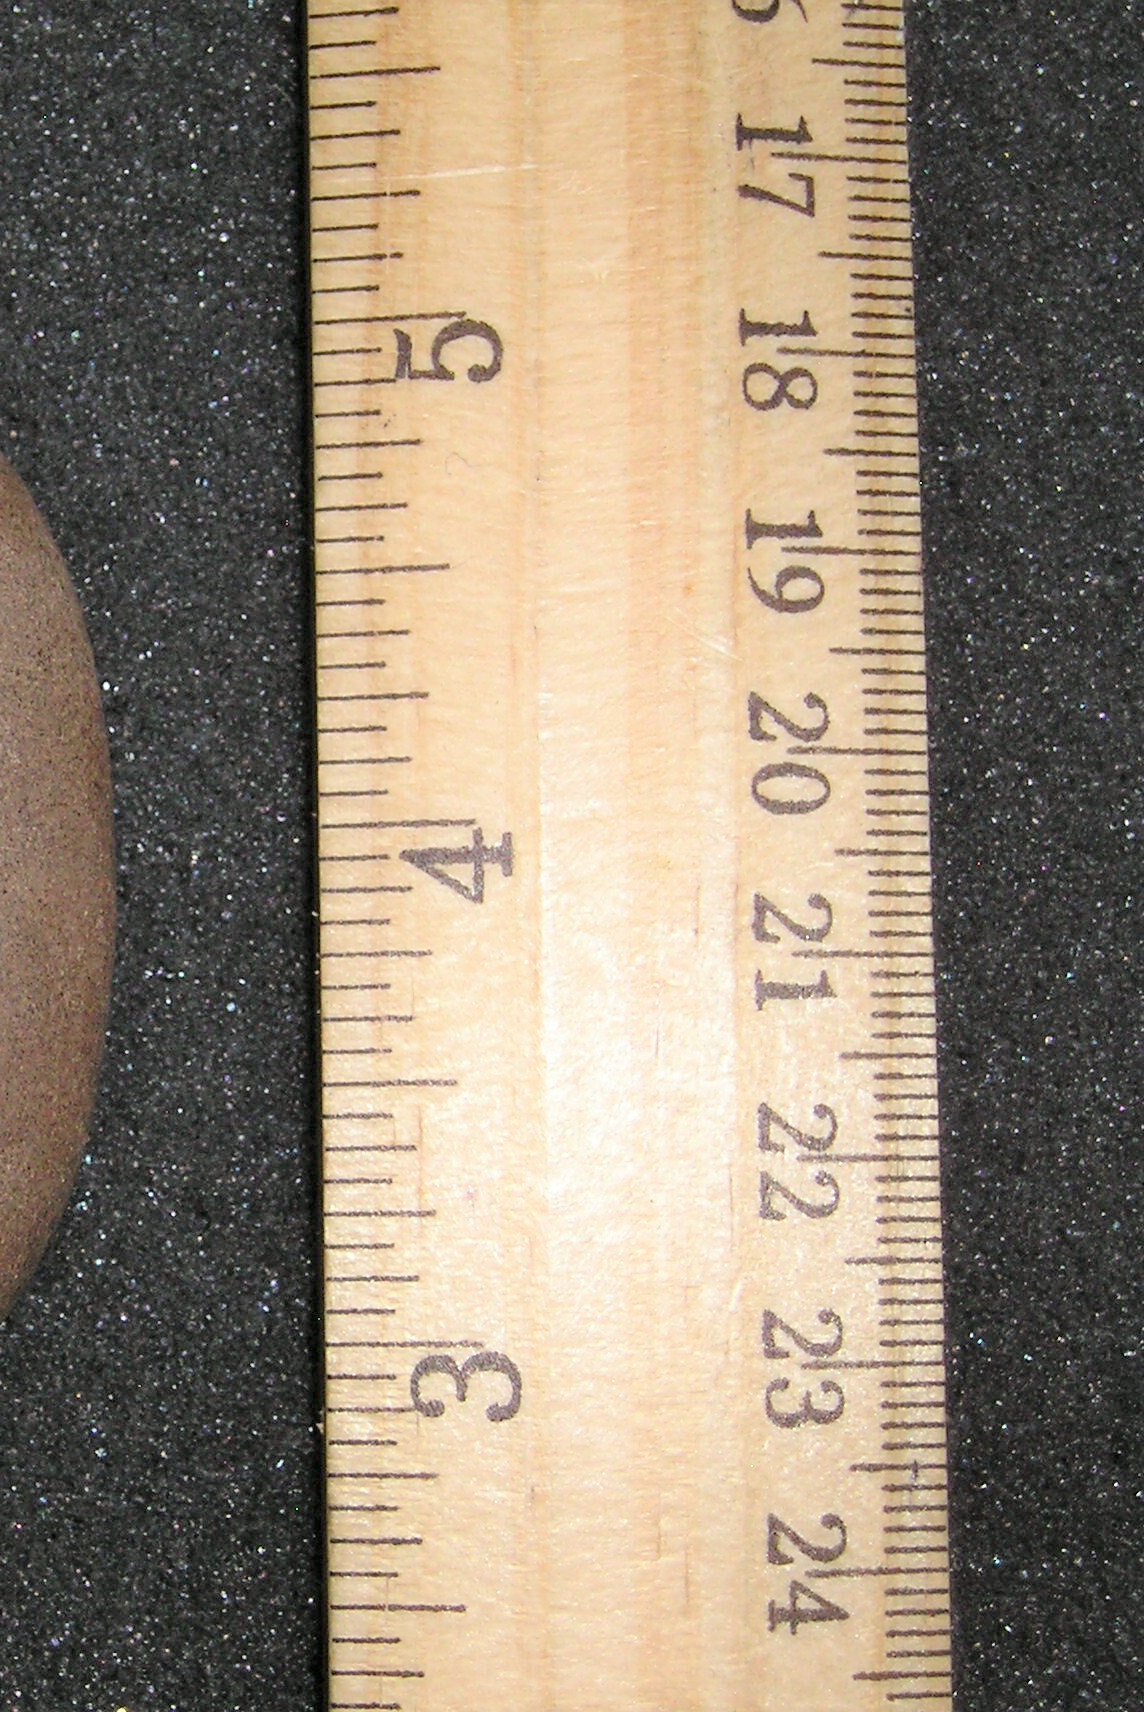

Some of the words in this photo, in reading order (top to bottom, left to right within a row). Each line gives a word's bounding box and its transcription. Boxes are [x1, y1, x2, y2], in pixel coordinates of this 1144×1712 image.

[735, 112, 816, 218] 17
[393, 318, 504, 383] 5
[738, 307, 818, 412] 18
[744, 507, 825, 614] 19
[747, 690, 832, 815] 20
[398, 826, 516, 905] 4
[751, 892, 837, 1012] 21
[757, 1101, 841, 1221] 22
[410, 1351, 522, 1422] 3
[761, 1308, 846, 1430] 23
[766, 1513, 850, 1636] 24
